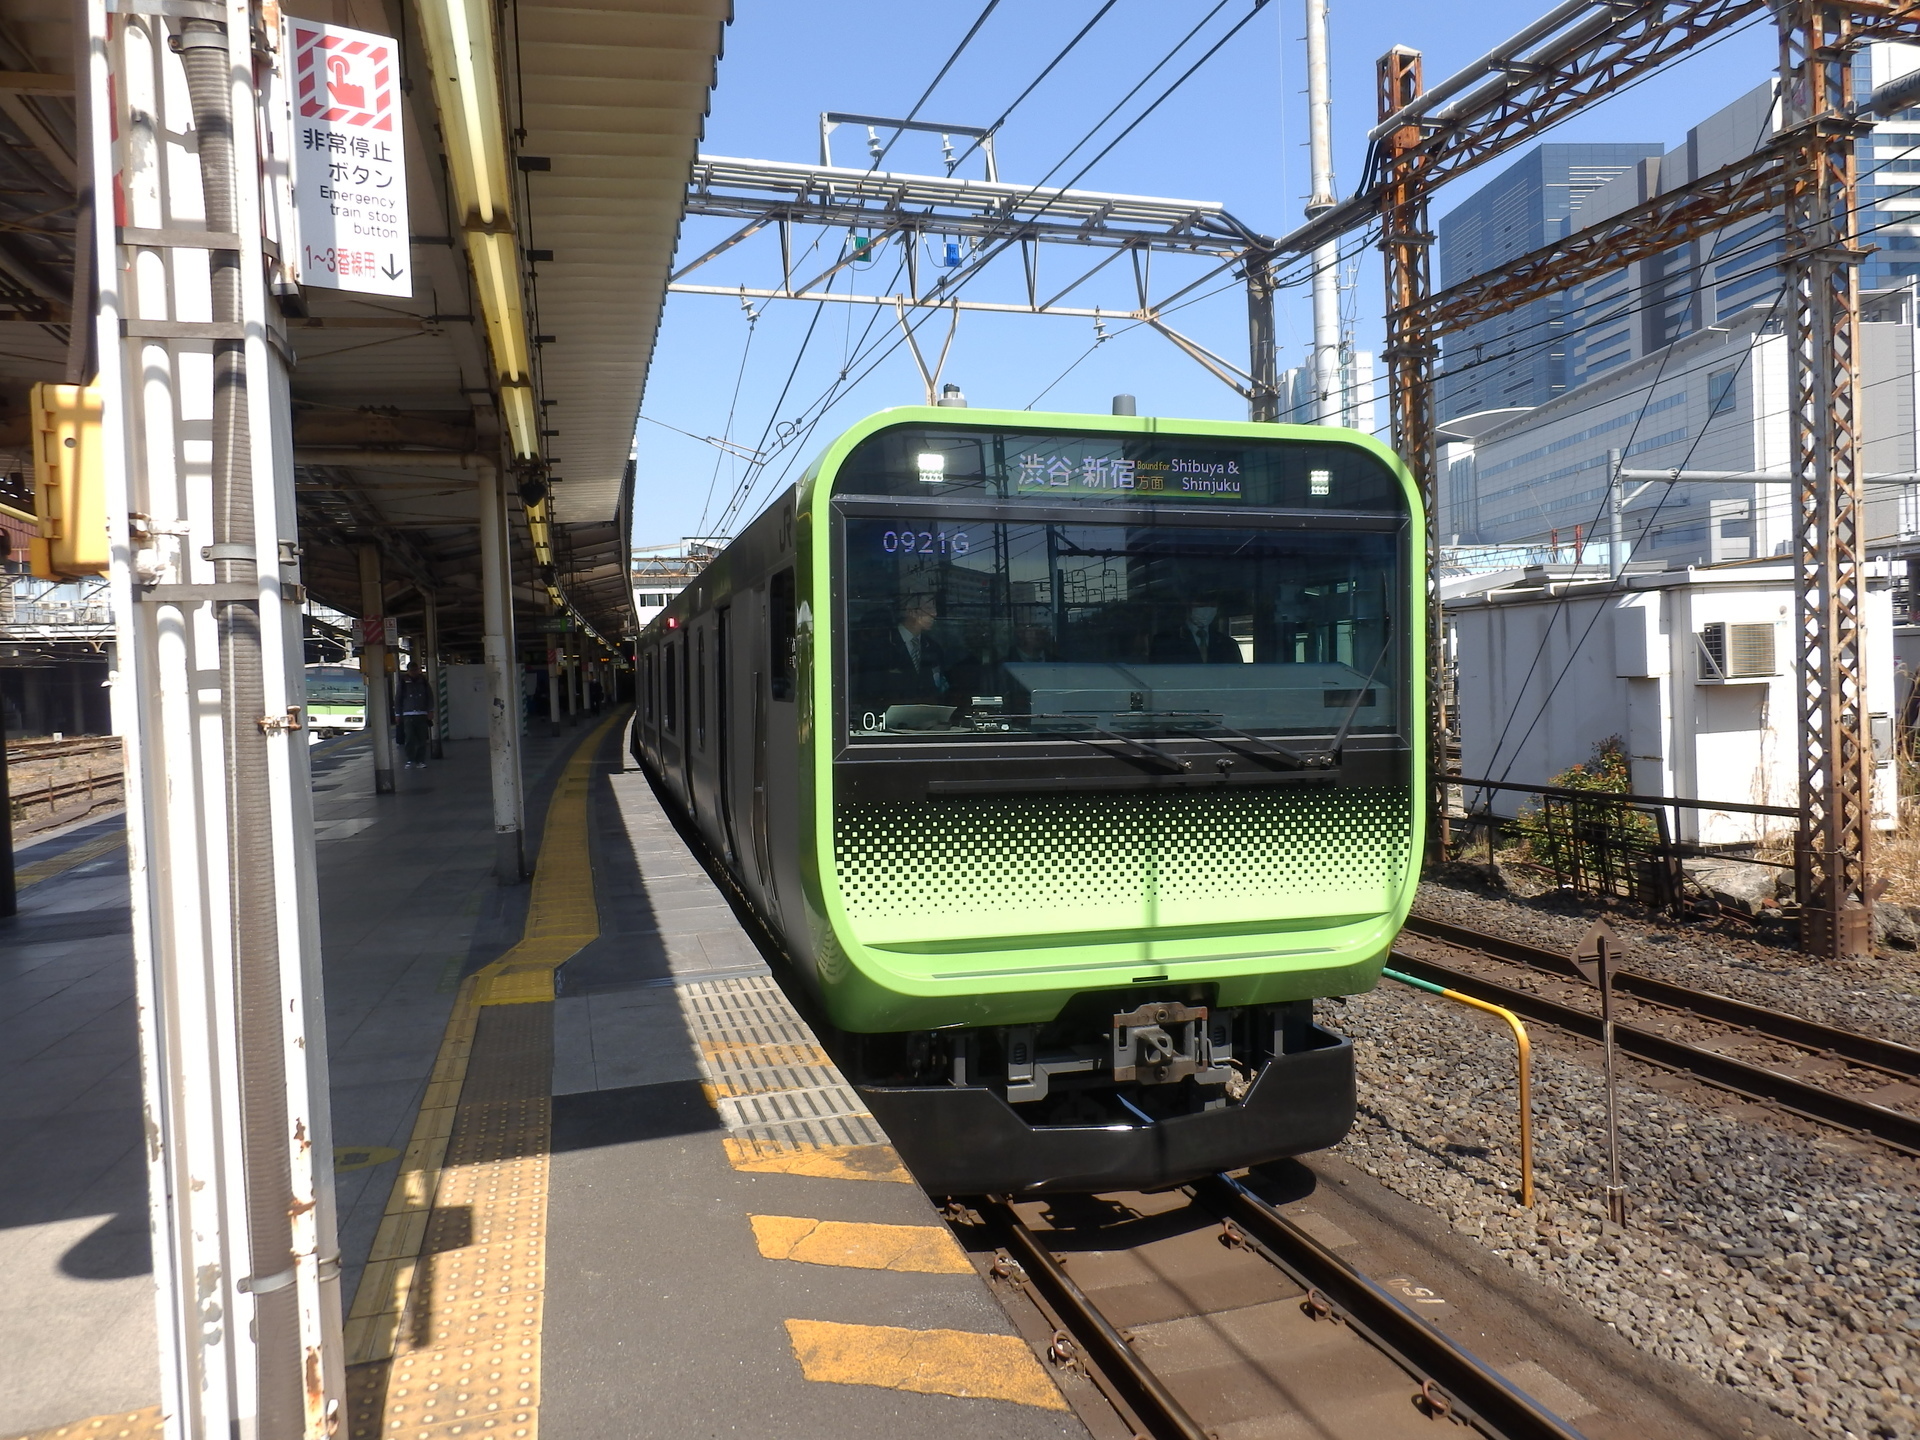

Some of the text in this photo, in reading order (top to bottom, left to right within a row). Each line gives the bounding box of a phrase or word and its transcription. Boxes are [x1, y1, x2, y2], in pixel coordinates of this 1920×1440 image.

[303, 128, 393, 163] 非常停止
[328, 162, 393, 188] ボタン
[320, 185, 396, 209] Emergency
[330, 203, 397, 224] train stop
[353, 221, 398, 239] button
[1171, 459, 1240, 476] Shibuya &
[1136, 475, 1164, 491] 方面
[1182, 477, 1241, 495] Shinjuku
[779, 504, 792, 554] JR
[883, 530, 970, 554] 0921G
[862, 711, 887, 731] 01
